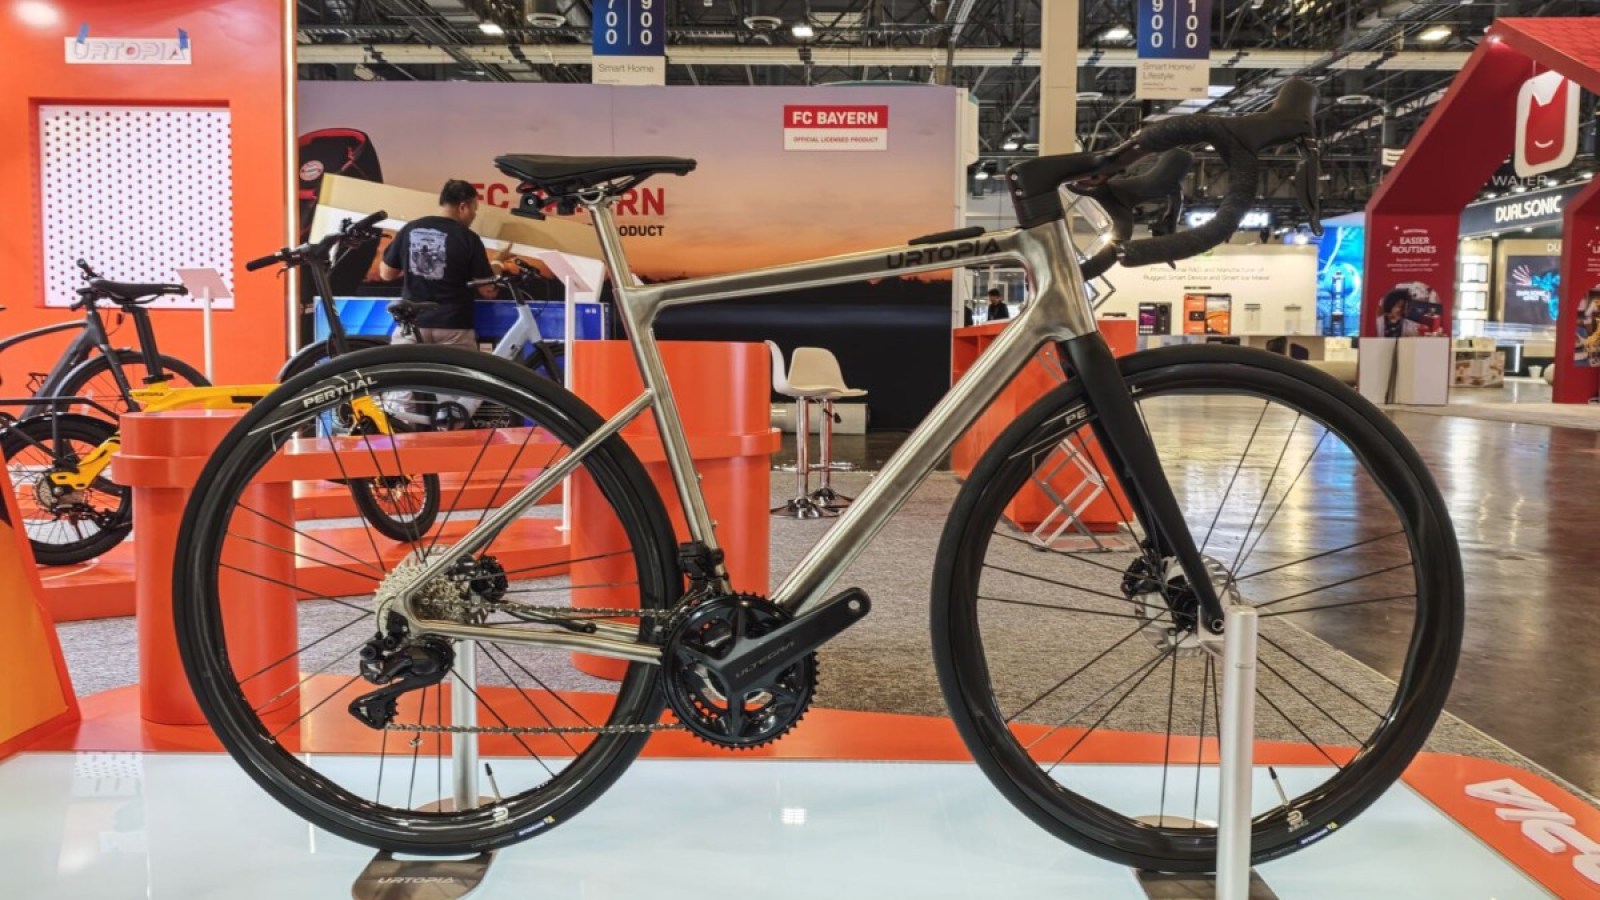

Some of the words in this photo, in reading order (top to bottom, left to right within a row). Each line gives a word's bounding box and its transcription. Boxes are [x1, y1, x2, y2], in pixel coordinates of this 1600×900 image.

[598, 63, 625, 73] Smart
[627, 63, 654, 73] Home
[1142, 62, 1167, 71] Smart
[792, 111, 813, 125] FC
[816, 111, 879, 125] BAYERN
[1495, 195, 1563, 223] DUALSONIC
[618, 224, 665, 237] ODUCT
[1399, 236, 1430, 245] EASIER
[886, 238, 1001, 270] URTOPIA
[1391, 246, 1437, 254] ROUTINES
[303, 376, 379, 409] PERTUAL
[377, 876, 455, 885] URTOPIA
